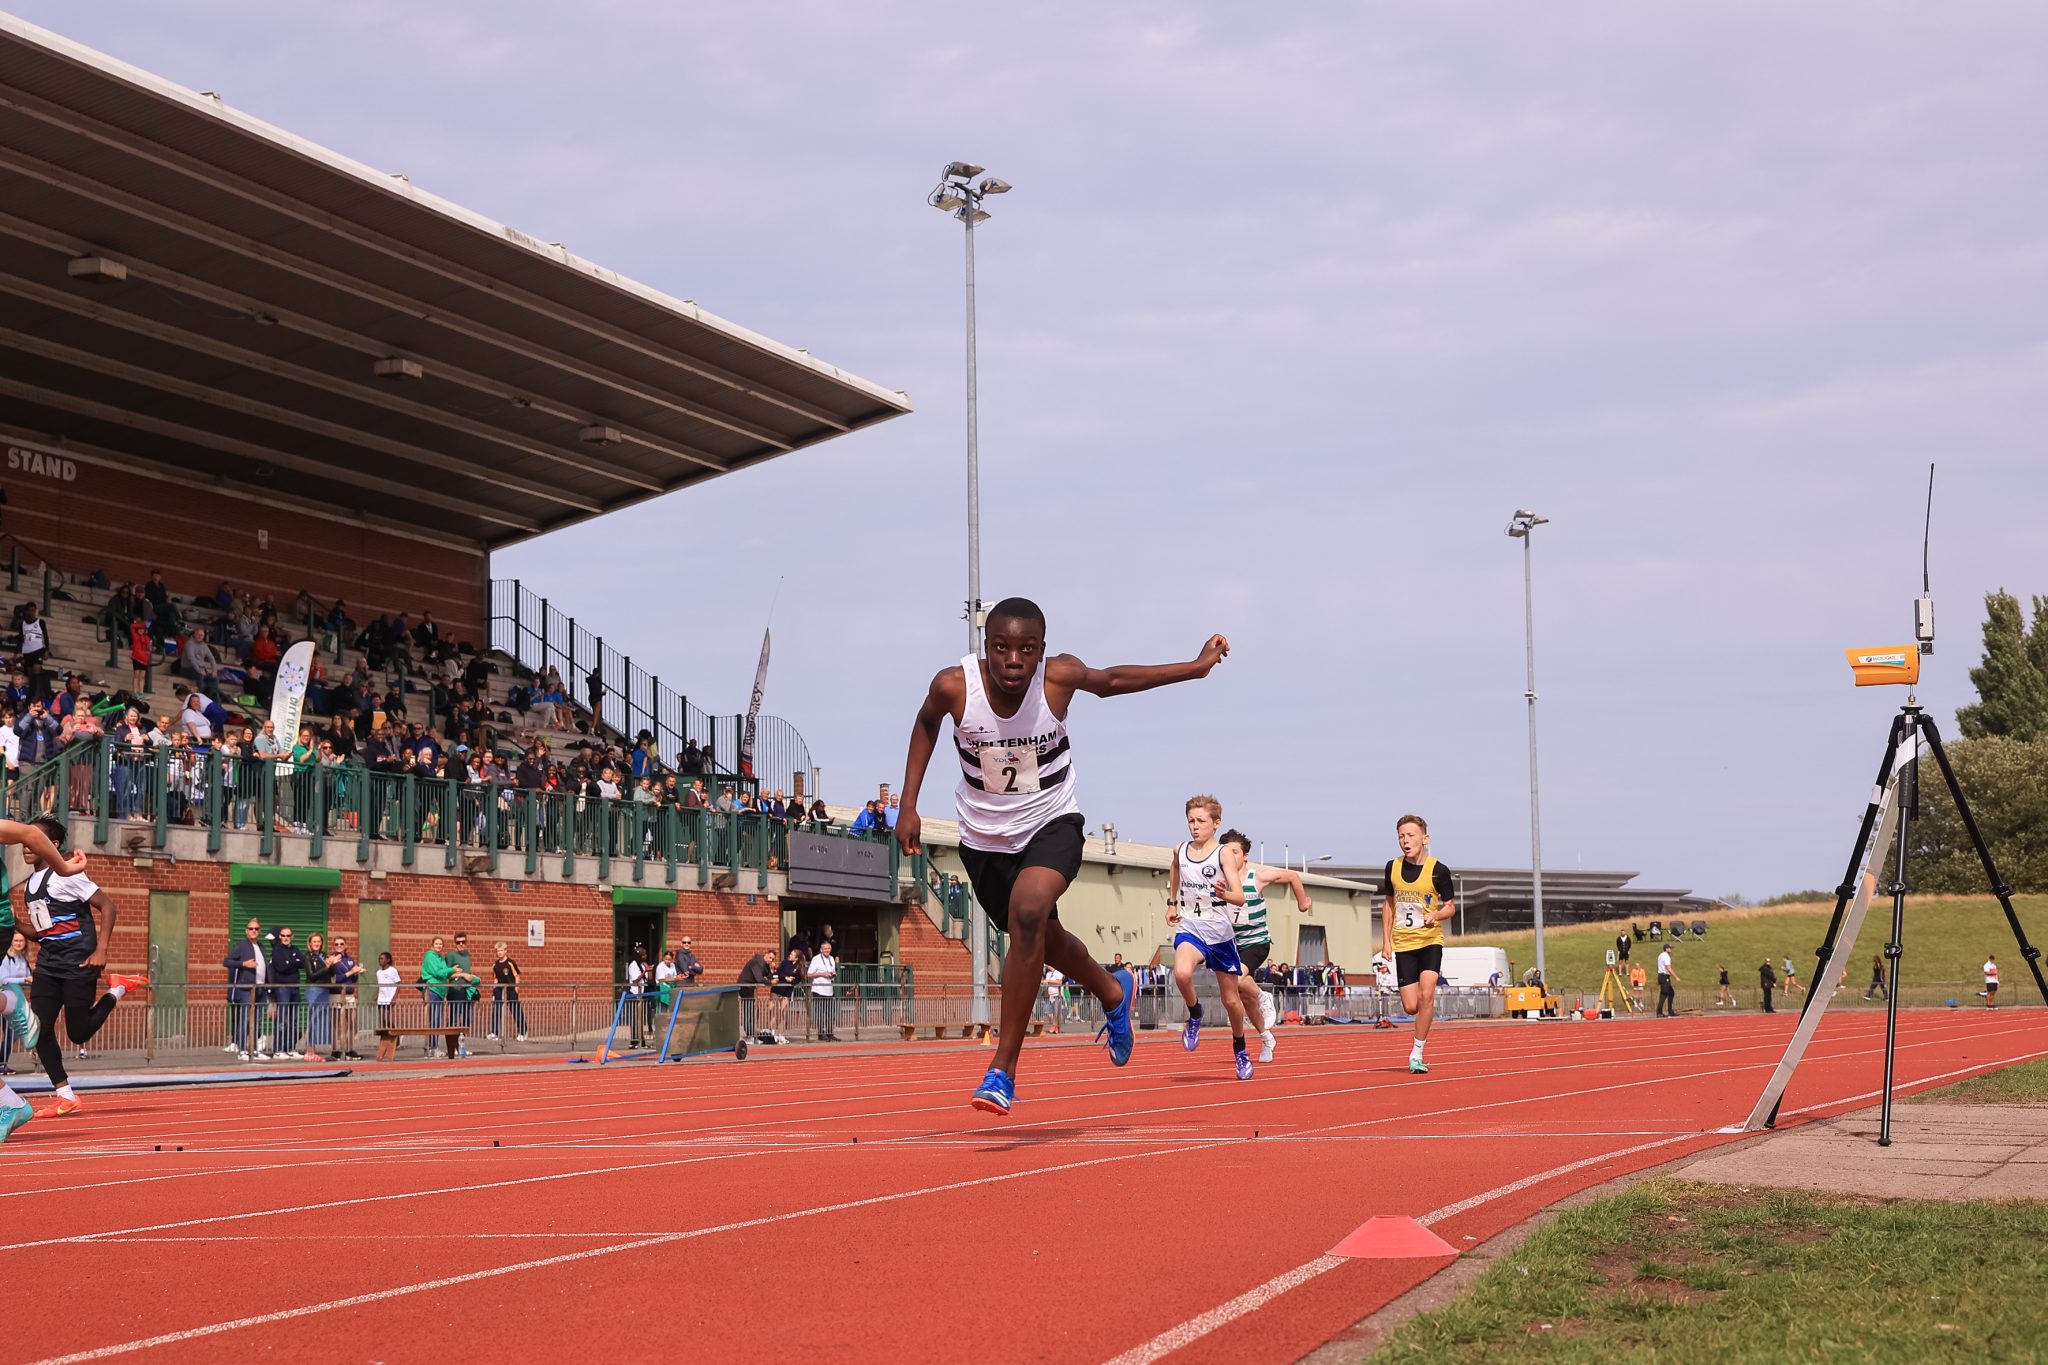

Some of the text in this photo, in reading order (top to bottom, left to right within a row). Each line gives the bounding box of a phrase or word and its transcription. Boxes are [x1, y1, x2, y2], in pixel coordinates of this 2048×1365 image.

[8, 446, 77, 481] STAND
[288, 697, 298, 717] CITY
[286, 718, 295, 730] OF
[1002, 766, 1018, 792] 2
[1194, 902, 1202, 917] 4
[1233, 911, 1240, 923] 7
[36, 913, 42, 928] 1
[1405, 913, 1413, 927] 5
